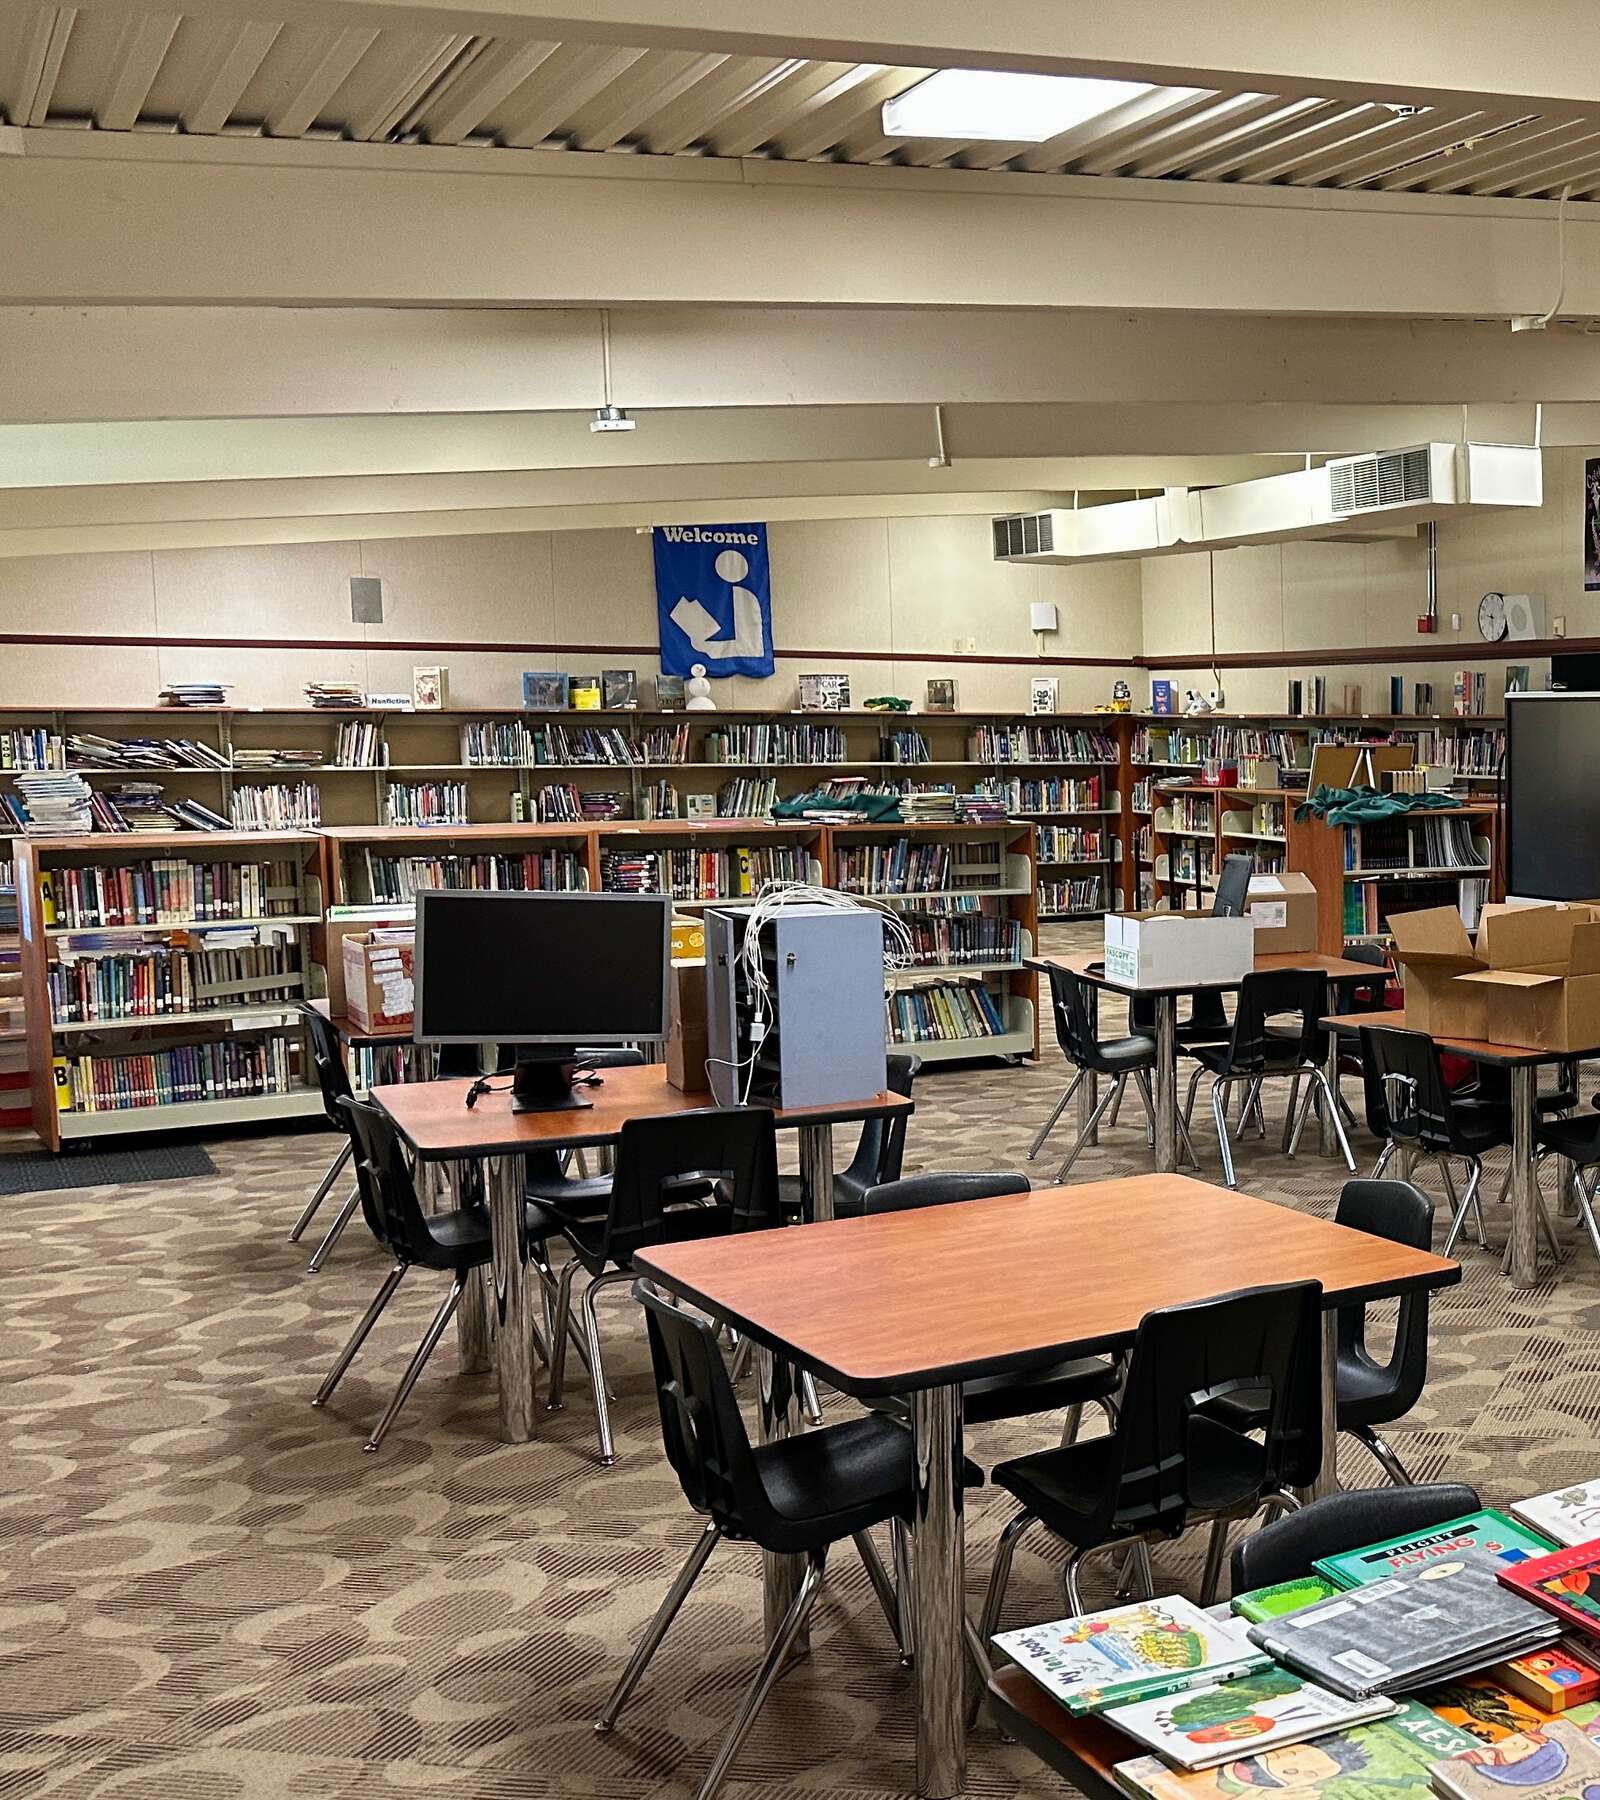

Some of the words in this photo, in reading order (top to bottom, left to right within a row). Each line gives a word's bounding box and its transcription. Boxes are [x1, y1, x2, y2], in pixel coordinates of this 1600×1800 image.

[662, 526, 759, 546] Welcome
[740, 856, 749, 873] C
[42, 882, 52, 901] A
[1384, 1530, 1456, 1558] FLIGHT
[1387, 1536, 1477, 1571] FLYING
[1018, 1636, 1050, 1659] Book
[1041, 1656, 1064, 1673] Ten
[1058, 1668, 1084, 1687] My
